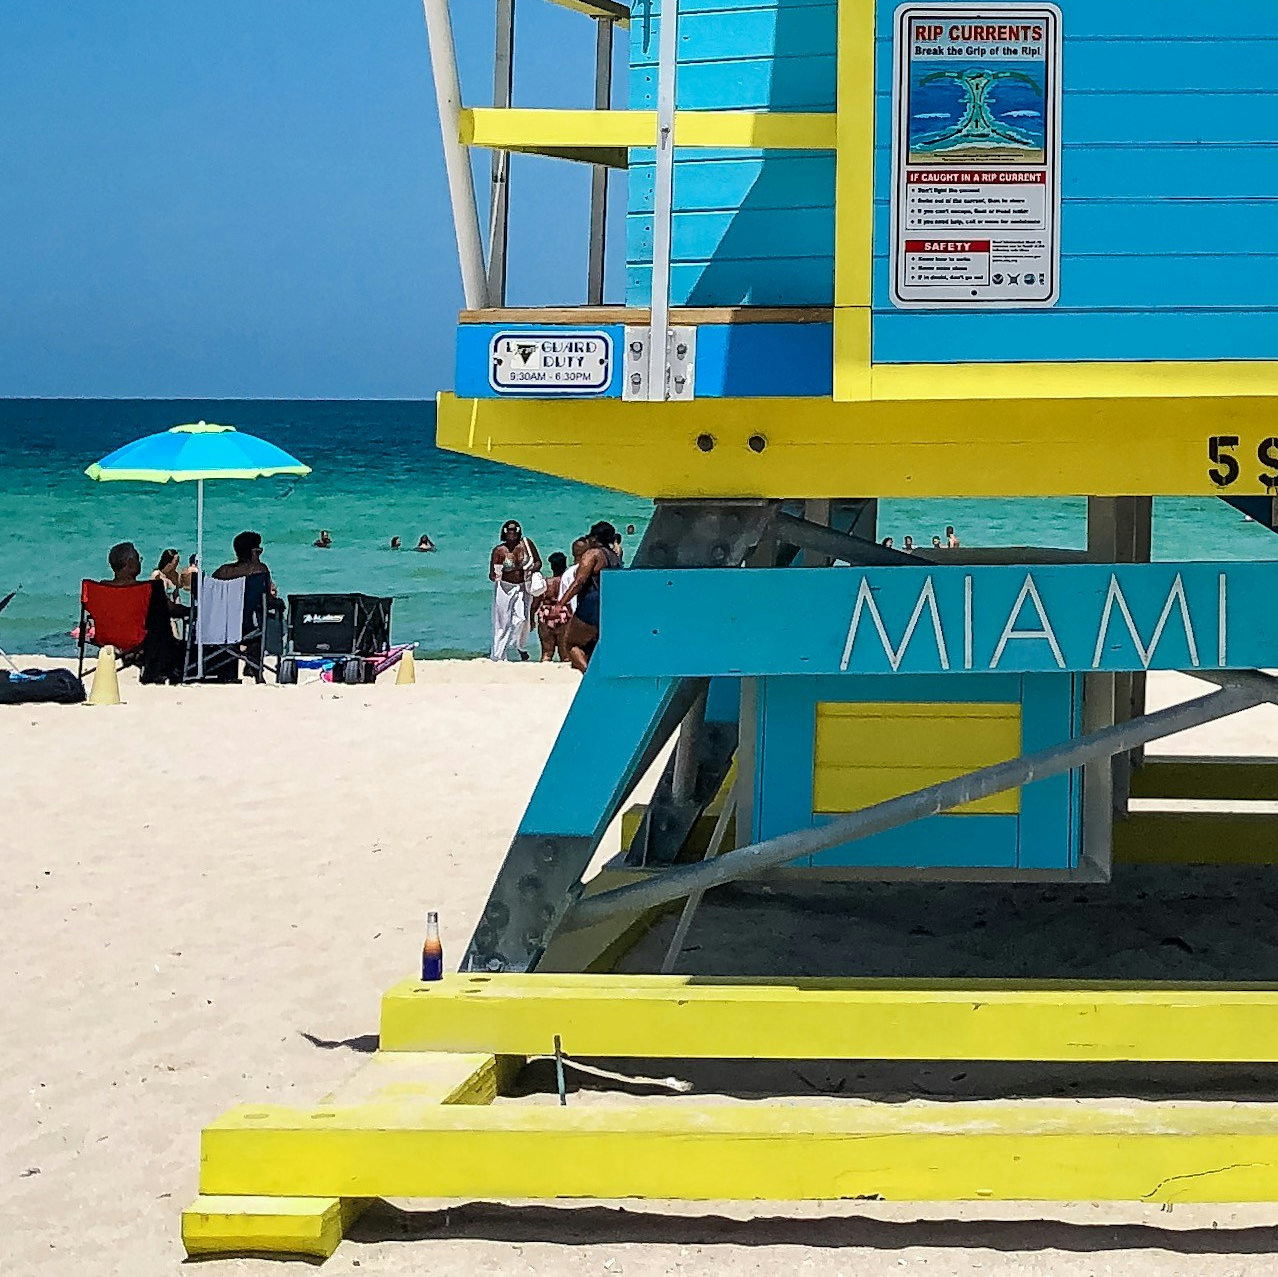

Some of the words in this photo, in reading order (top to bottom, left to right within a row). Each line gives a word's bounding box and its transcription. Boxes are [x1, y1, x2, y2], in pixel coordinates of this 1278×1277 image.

[915, 25, 943, 41] RIP
[949, 25, 1042, 41] CURRENTS
[914, 46, 944, 55] Break
[947, 46, 963, 55] the
[966, 46, 986, 57] Grip
[990, 46, 999, 55] of
[1002, 46, 1018, 55] the
[910, 173, 919, 181] IF
[921, 173, 959, 181] CAUGHT
[961, 173, 971, 181] IN
[973, 173, 980, 181] A
[982, 173, 997, 181] RIP
[999, 173, 1042, 181] CURRENT
[924, 242, 971, 251] SAFETY
[541, 342, 597, 352] GUARD
[543, 356, 585, 367] DUTY
[510, 372, 546, 381] 9:30AM
[1208, 436, 1239, 487] 5
[840, 573, 1226, 671] MIAMI
